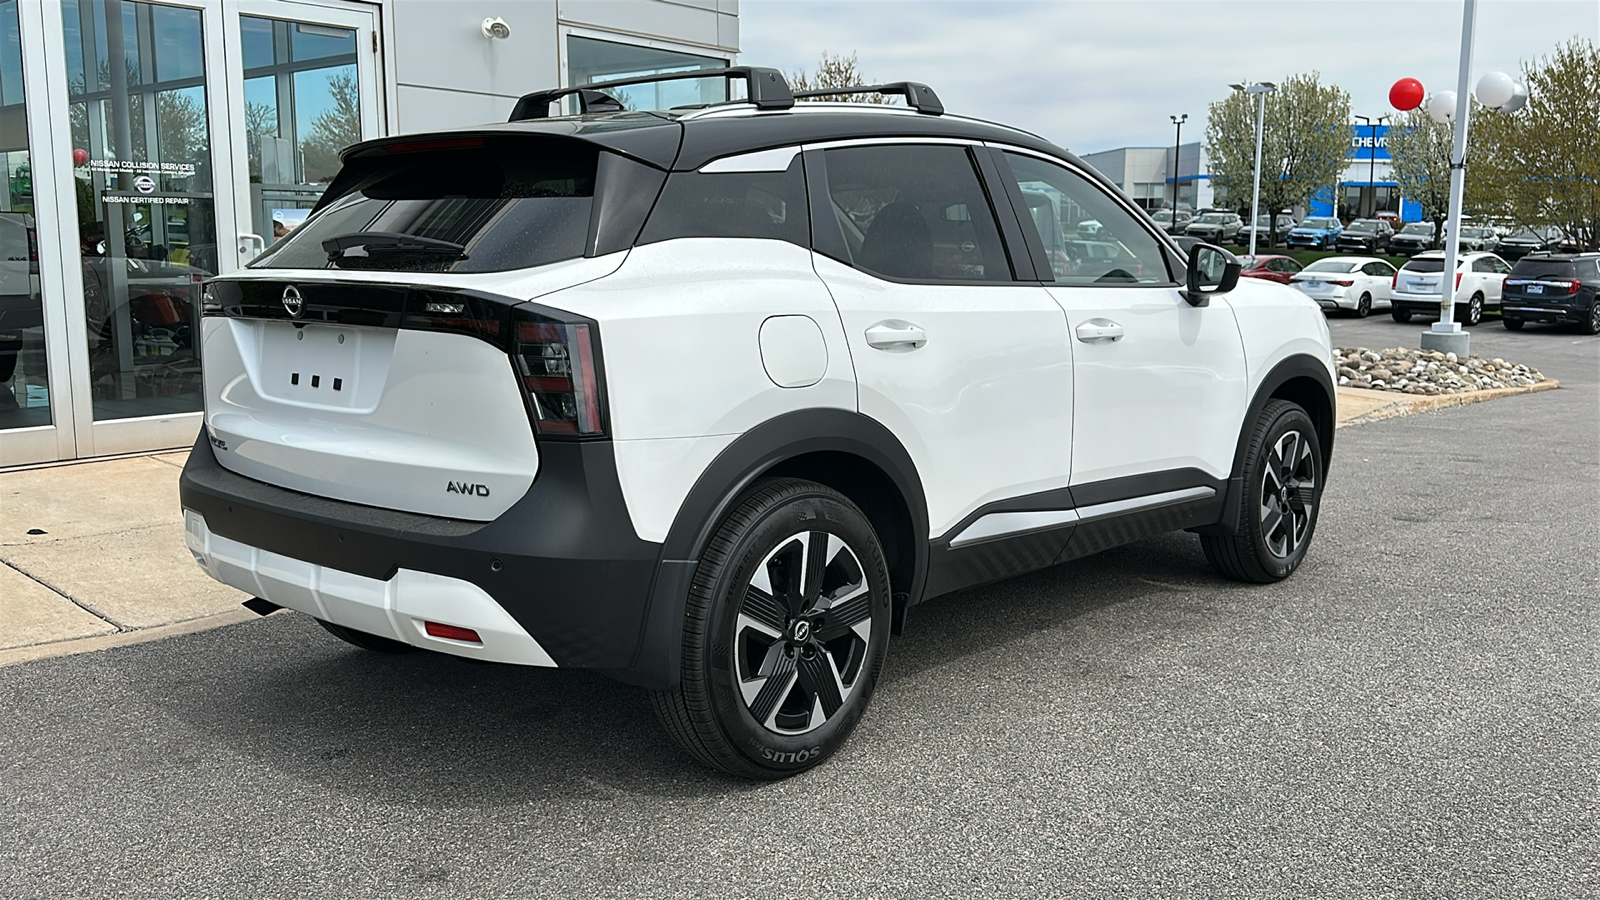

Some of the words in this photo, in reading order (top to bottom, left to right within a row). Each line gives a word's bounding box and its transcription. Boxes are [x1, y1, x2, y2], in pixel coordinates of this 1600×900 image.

[90, 160, 120, 168] NISSAN
[121, 161, 159, 169] COLLISION
[161, 163, 195, 171] SERVICES
[446, 480, 490, 497] AWD
[867, 536, 889, 608] KUMHO
[761, 746, 821, 763] SOLUS
